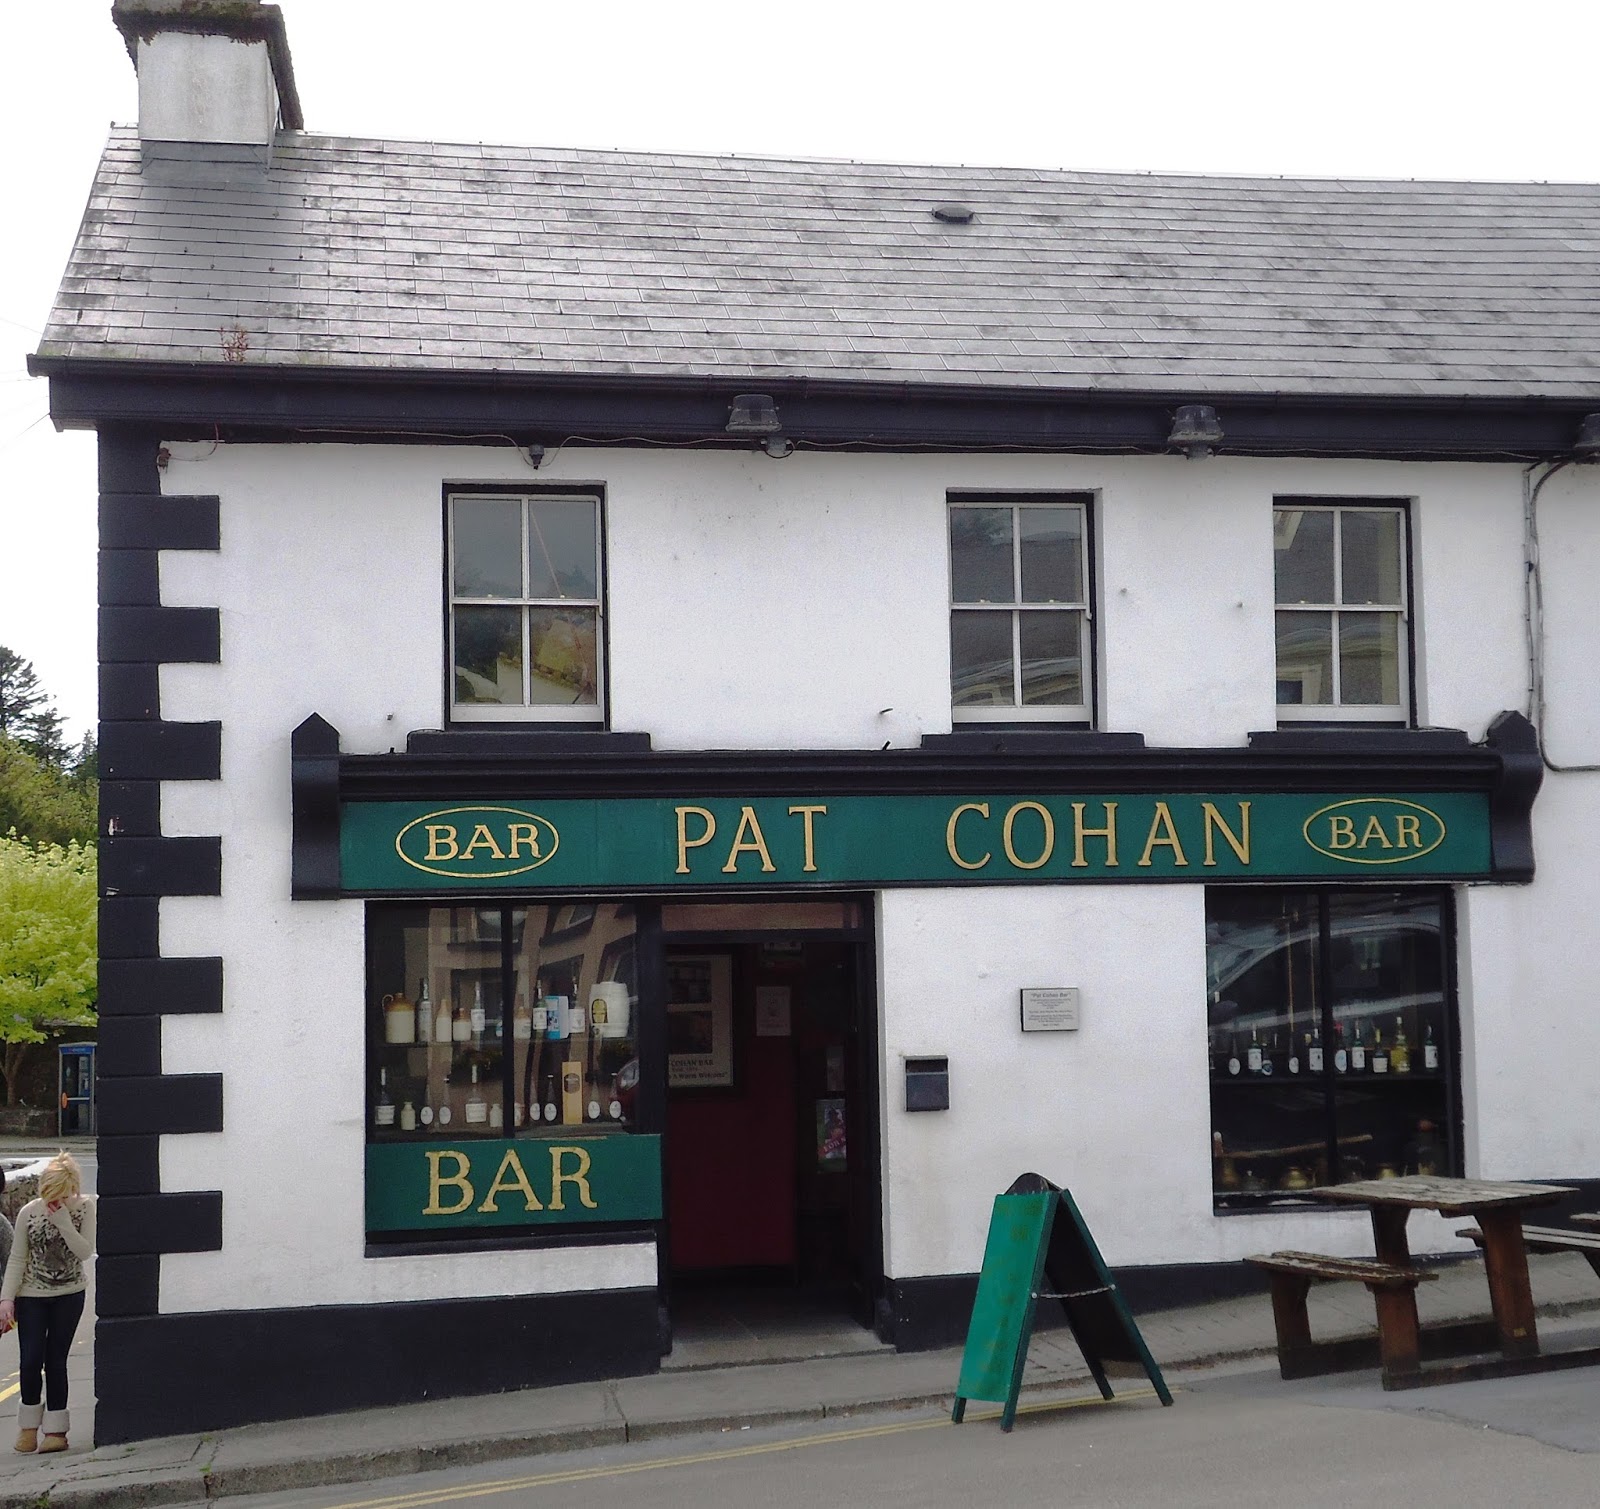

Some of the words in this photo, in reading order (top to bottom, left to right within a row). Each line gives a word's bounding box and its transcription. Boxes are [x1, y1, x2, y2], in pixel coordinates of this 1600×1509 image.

[423, 822, 541, 862] BAR
[674, 804, 828, 874] PAT
[945, 800, 1252, 870] COHAN
[1328, 814, 1423, 850] BAR
[422, 1145, 598, 1216] BAR
